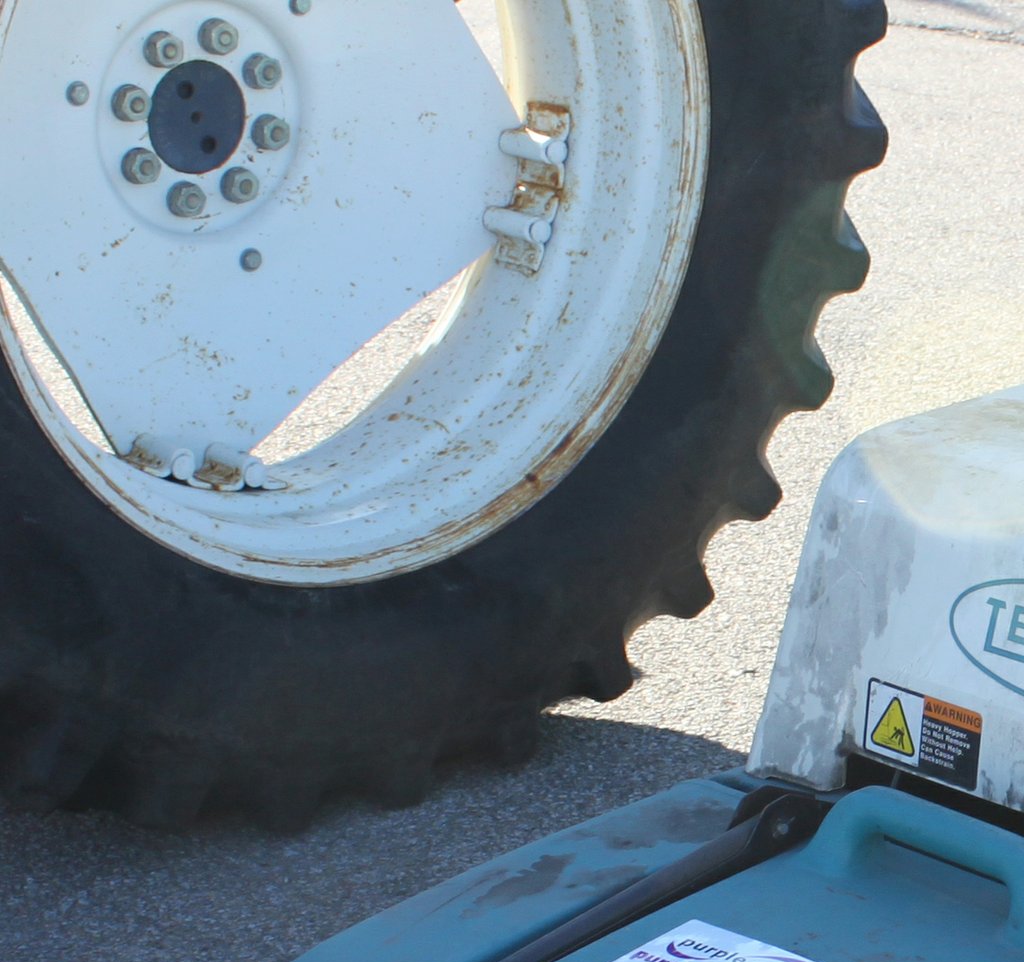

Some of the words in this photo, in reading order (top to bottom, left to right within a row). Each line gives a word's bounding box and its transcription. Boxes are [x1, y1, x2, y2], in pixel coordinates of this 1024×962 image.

[930, 703, 981, 728] WARNING
[921, 735, 946, 750] Without
[922, 727, 931, 736] Do
[932, 730, 944, 740] Not
[945, 735, 970, 750] Remove
[920, 743, 933, 754] Can
[934, 748, 954, 761] Cause
